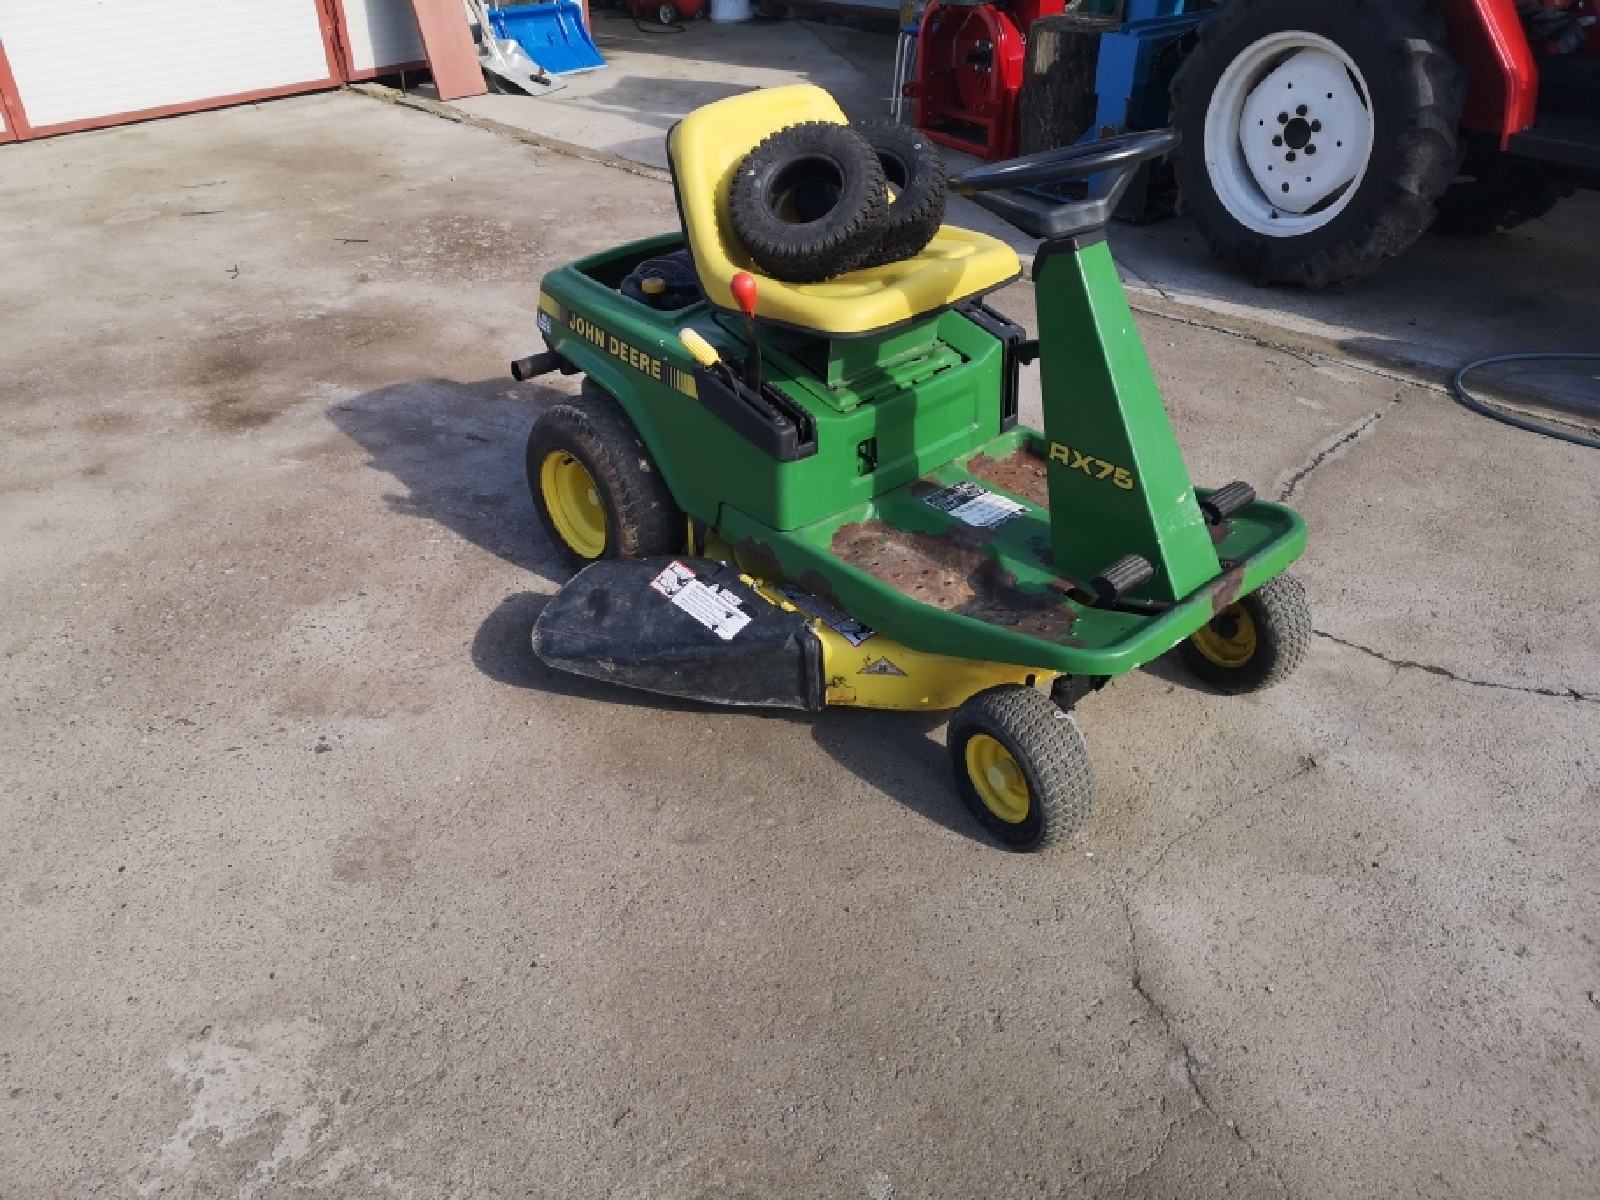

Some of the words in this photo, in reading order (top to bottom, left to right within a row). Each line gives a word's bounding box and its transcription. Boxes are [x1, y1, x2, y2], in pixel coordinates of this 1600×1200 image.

[569, 312, 605, 348] JOHN
[610, 336, 662, 380] DEERE
[1048, 441, 1134, 490] RX75
